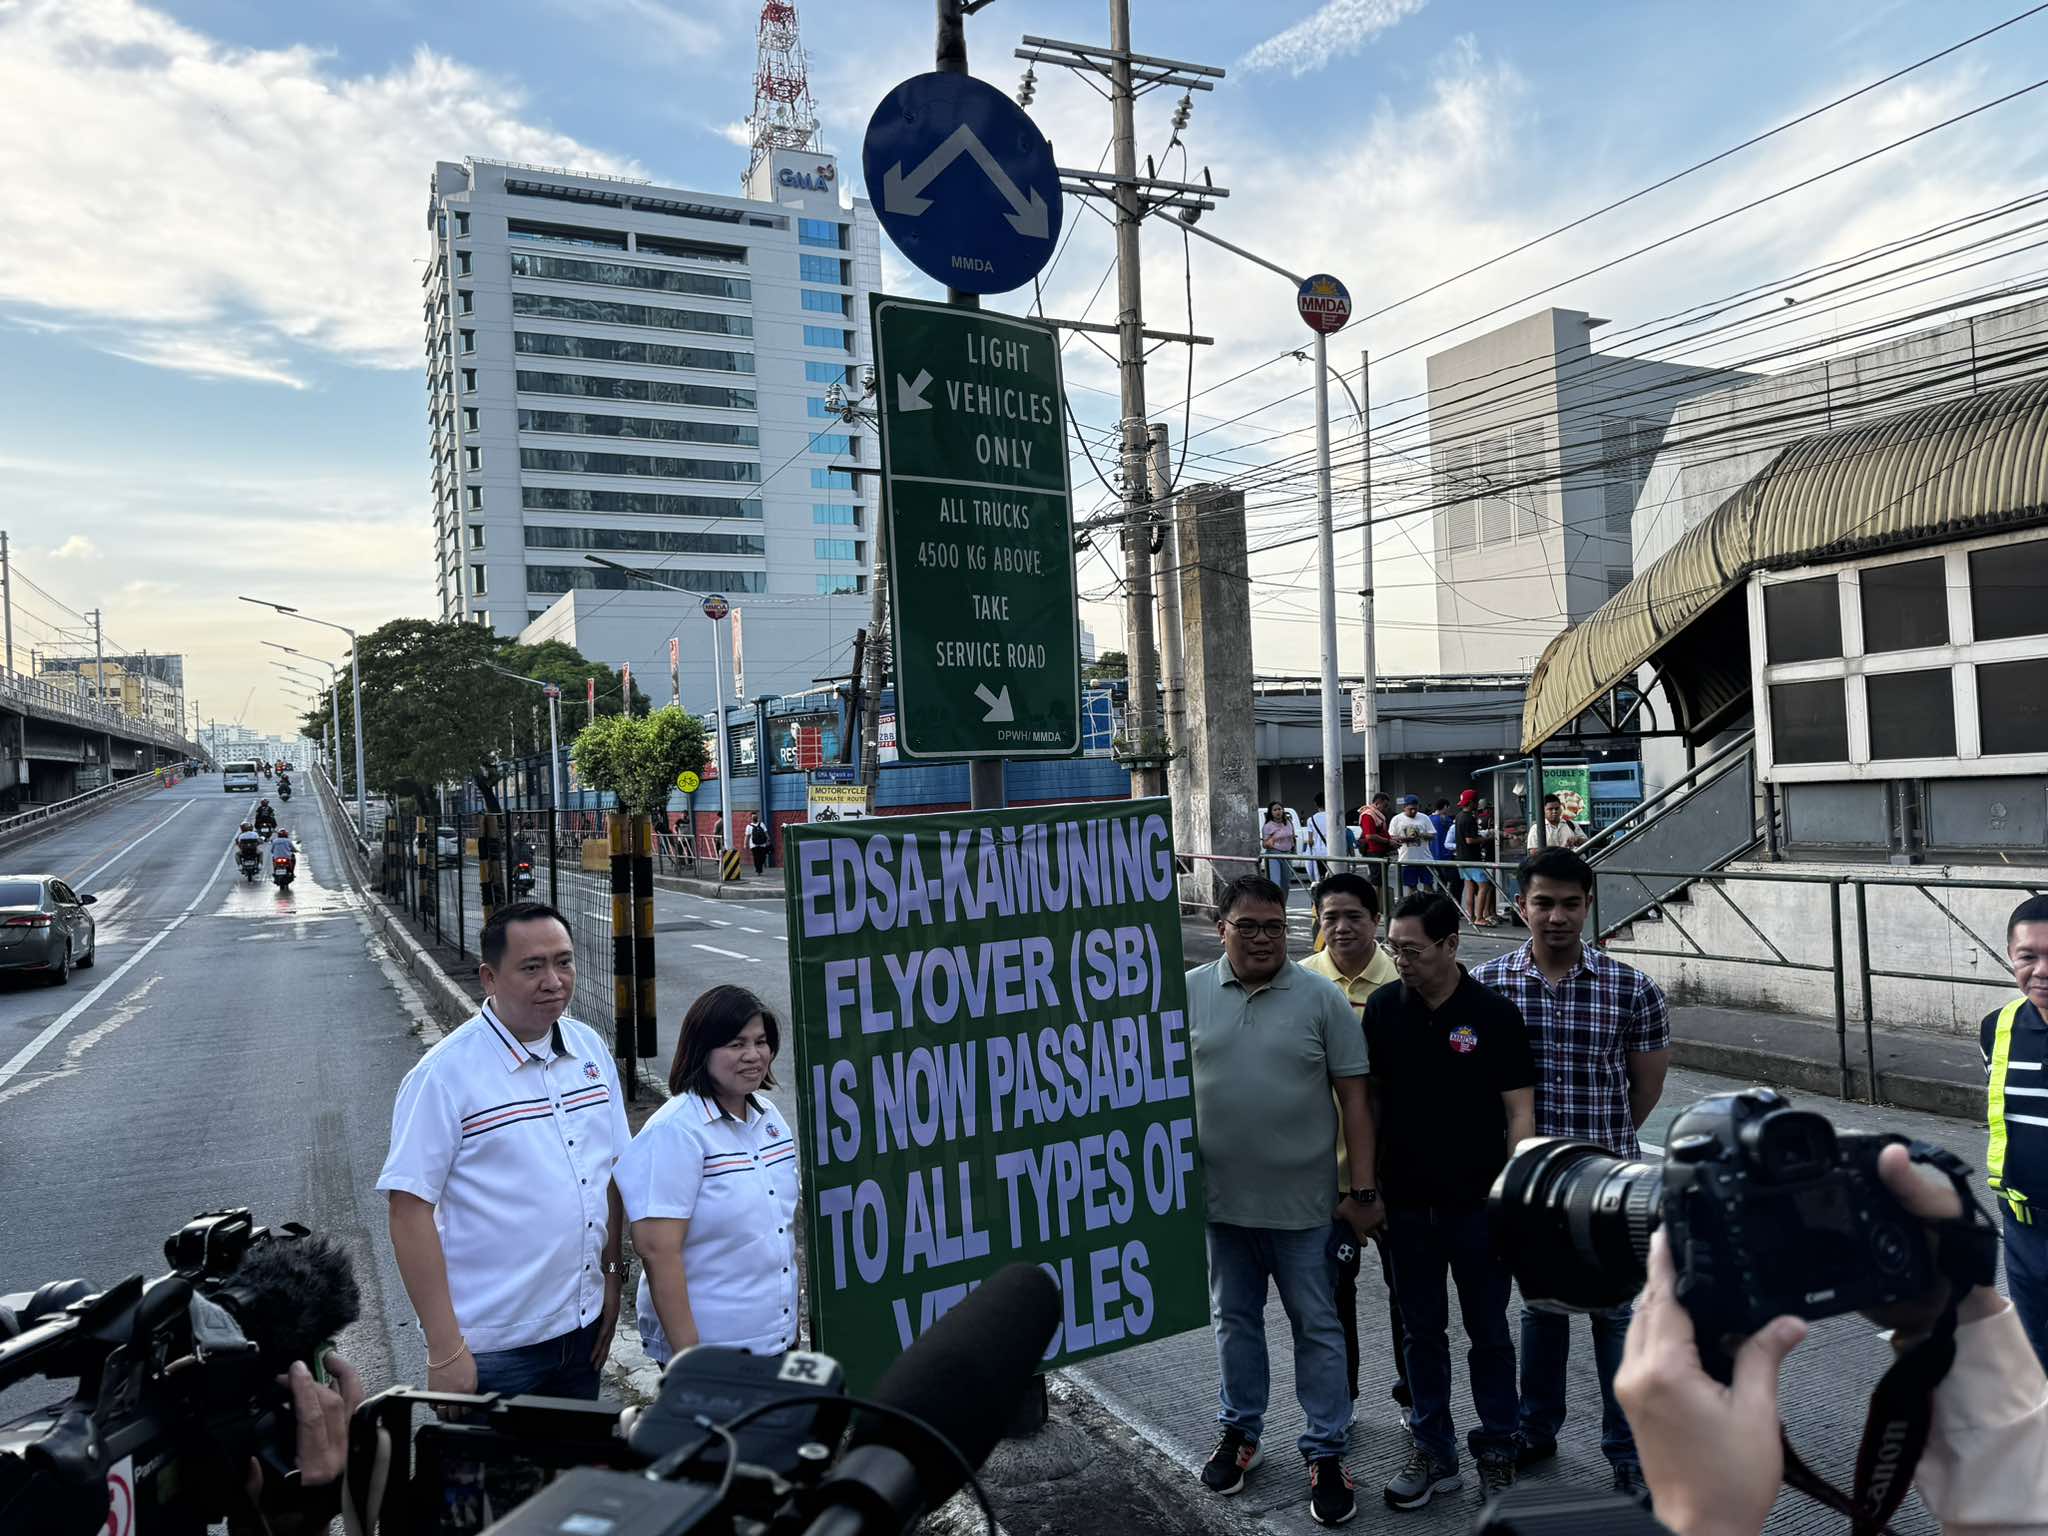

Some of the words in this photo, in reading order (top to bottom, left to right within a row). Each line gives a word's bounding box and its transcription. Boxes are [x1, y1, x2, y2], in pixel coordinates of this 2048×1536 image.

[951, 254, 995, 274] MMDA
[1301, 296, 1347, 314] MMDA
[967, 333, 1030, 373] LIGHT
[945, 379, 1053, 425] VEHICLES
[976, 433, 1033, 470] ONLY
[939, 497, 968, 524] ALL
[973, 500, 1031, 530] TRUCKS
[918, 542, 960, 569] 4500
[967, 545, 986, 570] KG
[993, 548, 1042, 575] ABOVE
[972, 595, 1010, 621] TAKE
[936, 641, 1002, 668] SERVICE
[1007, 643, 1047, 669] ROAD
[1032, 731, 1062, 742] MMDA
[815, 787, 866, 795] MOTORCYCLE
[800, 814, 1174, 938] EDSA-KAMUNING
[825, 936, 1062, 1040] FLYOVER
[1070, 923, 1163, 1023] (SB)
[813, 1059, 862, 1166] IS
[872, 1040, 977, 1155] NOW
[986, 1010, 1192, 1133] PASSABLE
[819, 1179, 889, 1291] TO
[902, 1161, 990, 1275] ALL
[996, 1129, 1135, 1249] TYPES
[1143, 1118, 1194, 1216] OF
[892, 1239, 1155, 1362] VLES
